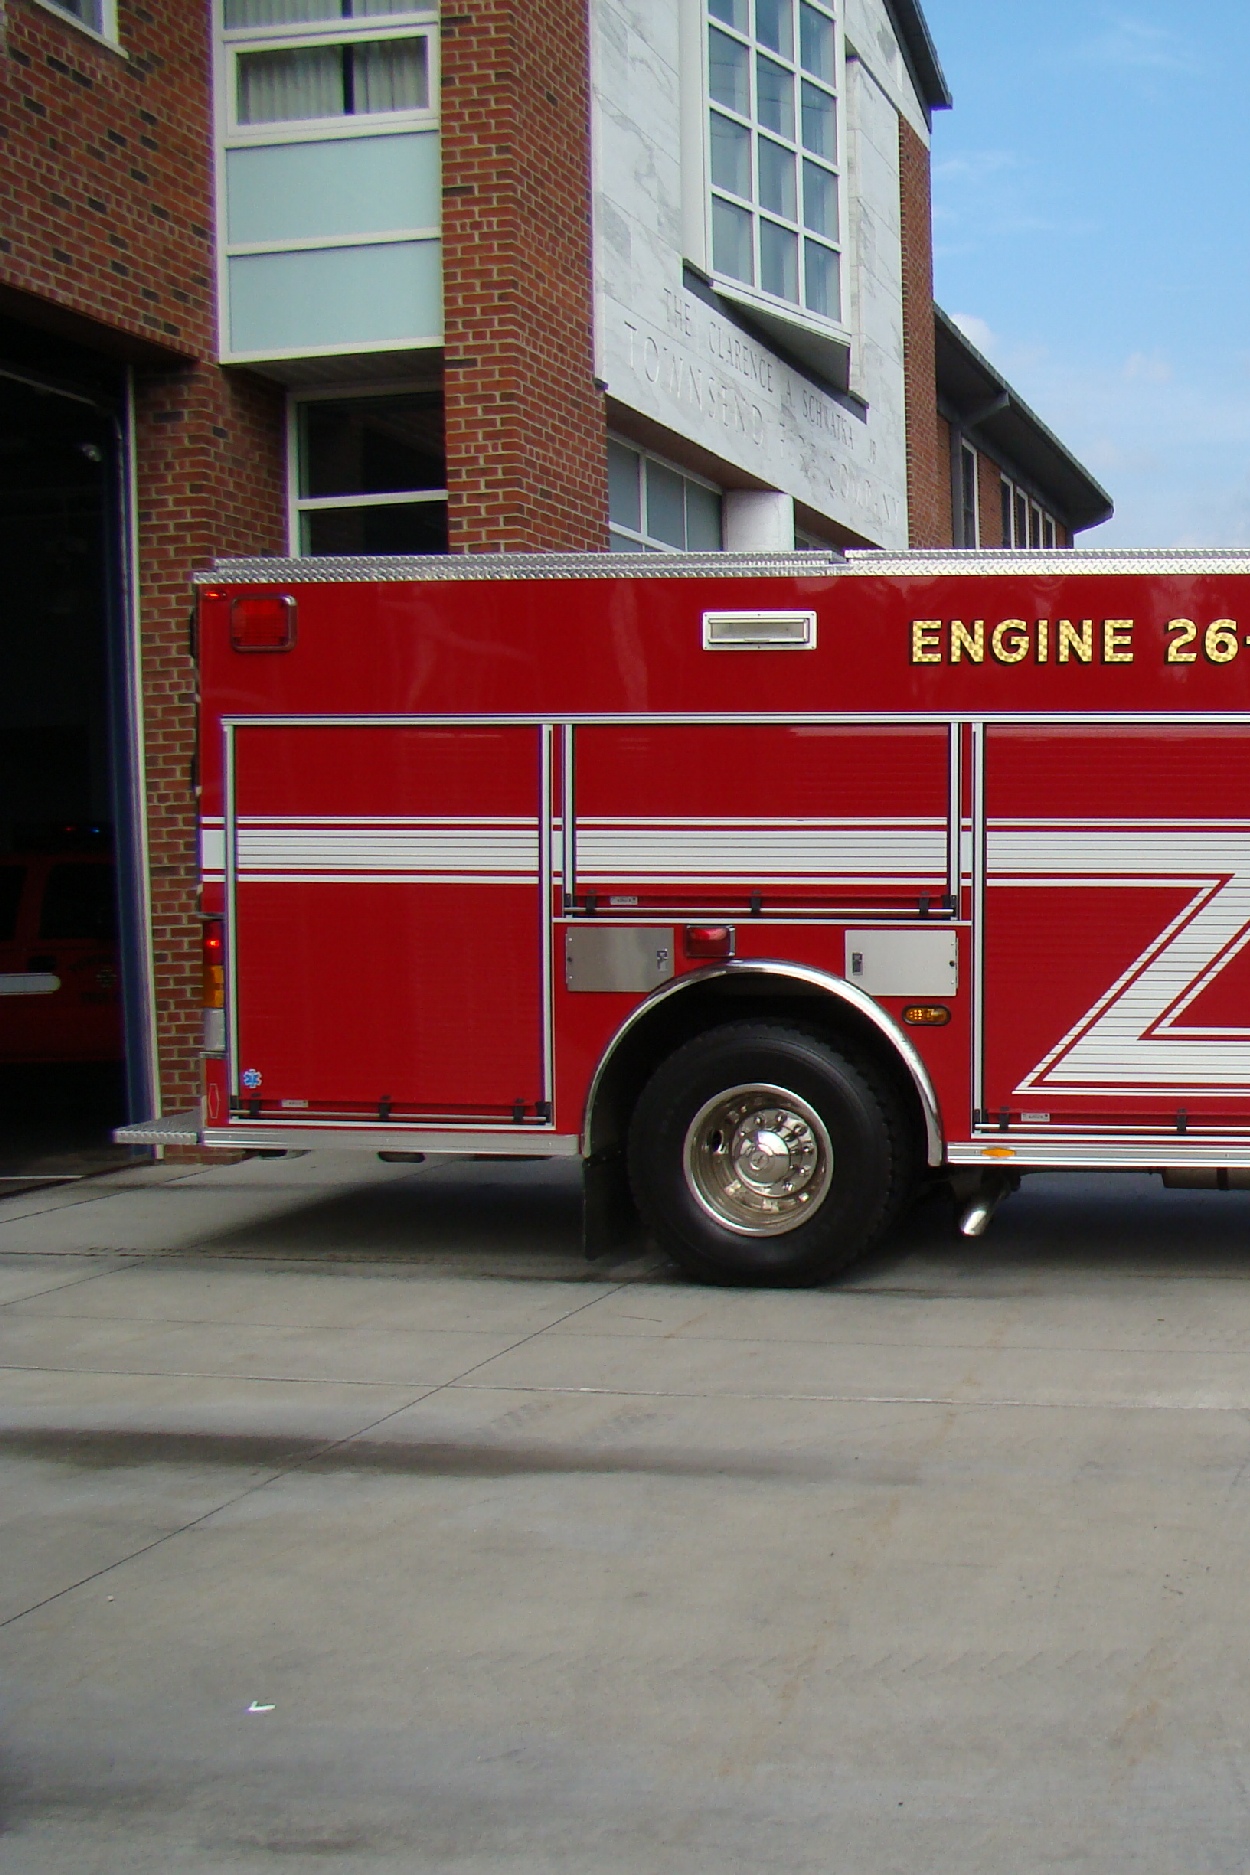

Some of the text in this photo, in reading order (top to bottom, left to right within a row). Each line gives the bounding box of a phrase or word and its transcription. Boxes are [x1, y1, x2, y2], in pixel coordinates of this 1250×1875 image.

[623, 319, 766, 446] TOWNSEND
[663, 287, 691, 337] THE
[708, 321, 774, 393] CLARENCE
[909, 619, 1135, 664] ENGINE
